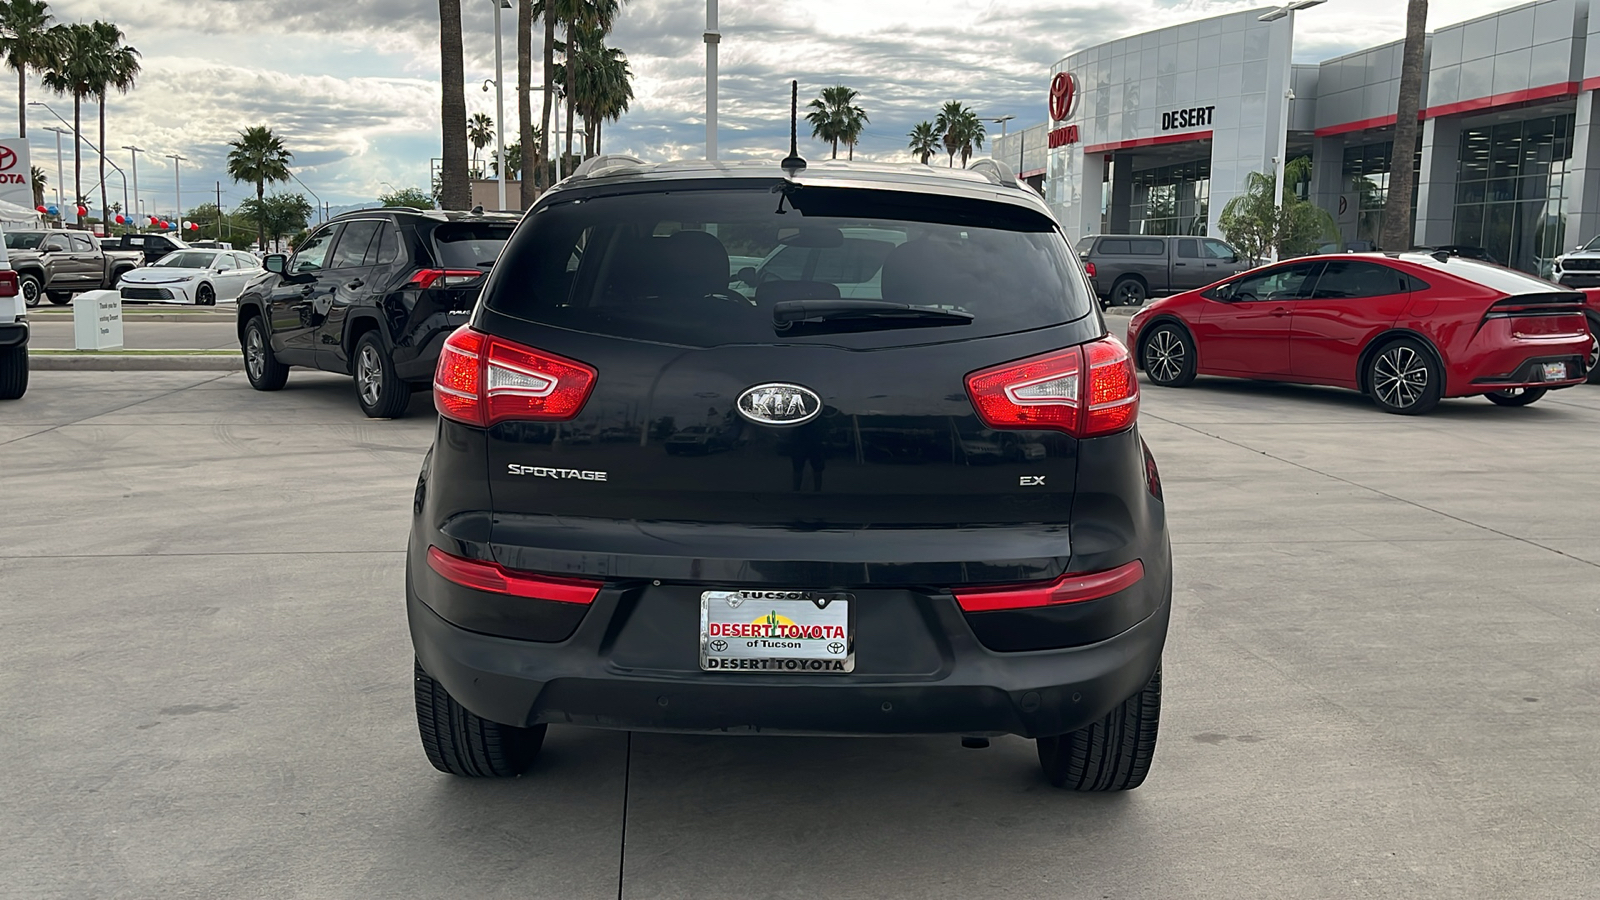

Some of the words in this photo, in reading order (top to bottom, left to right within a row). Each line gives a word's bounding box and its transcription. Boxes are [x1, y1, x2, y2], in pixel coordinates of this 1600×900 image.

[1162, 106, 1215, 130] DESERT
[1048, 125, 1078, 148] TOYOTA
[752, 394, 807, 416] KIA
[508, 464, 607, 481] SPORTAGE
[1020, 476, 1045, 485] EX
[741, 591, 812, 600] TUCSON
[710, 623, 772, 637] DESERT
[778, 625, 845, 639] TOYOTA
[746, 640, 758, 648] of
[760, 640, 801, 649] Tucson
[708, 658, 769, 669] DESERT
[775, 659, 845, 671] TOYOTA
